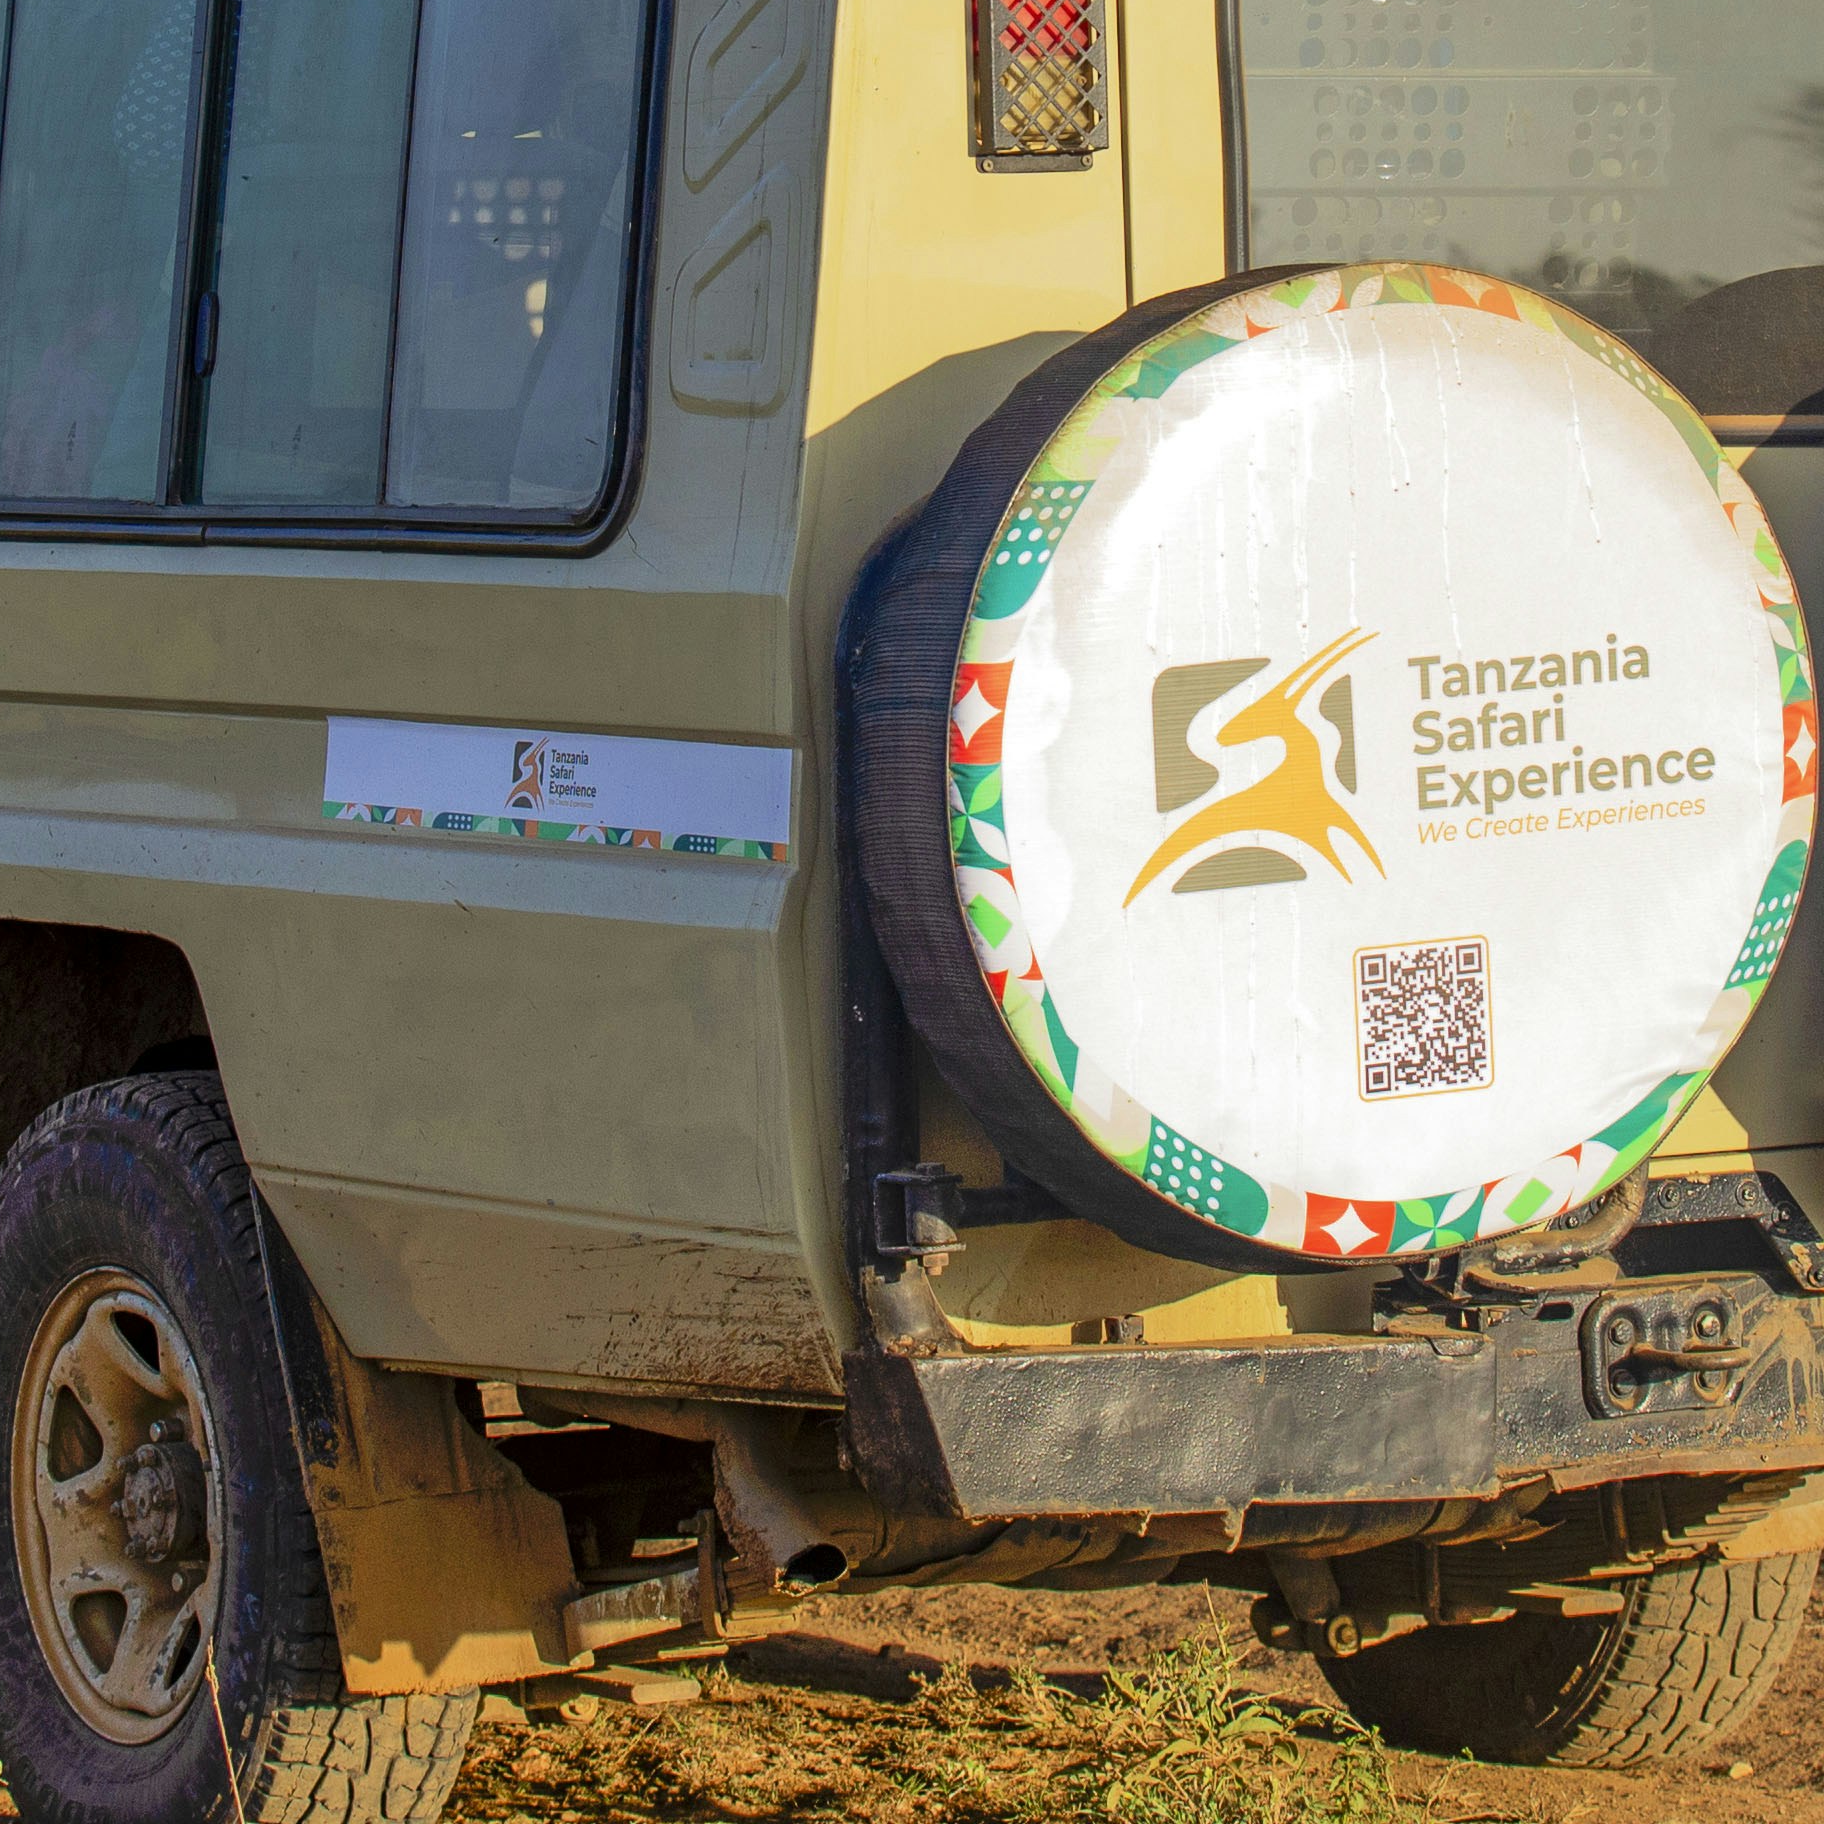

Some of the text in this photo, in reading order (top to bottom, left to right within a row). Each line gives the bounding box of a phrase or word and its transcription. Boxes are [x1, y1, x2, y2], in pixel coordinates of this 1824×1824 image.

[1407, 633, 1650, 700] Tanzania
[1412, 692, 1566, 756] Safari
[550, 764, 575, 780] Safari
[551, 749, 589, 765] Tanzania
[1416, 745, 1716, 815] Experience
[549, 780, 597, 798] Experience
[1417, 797, 1707, 845] We Create Experiences
